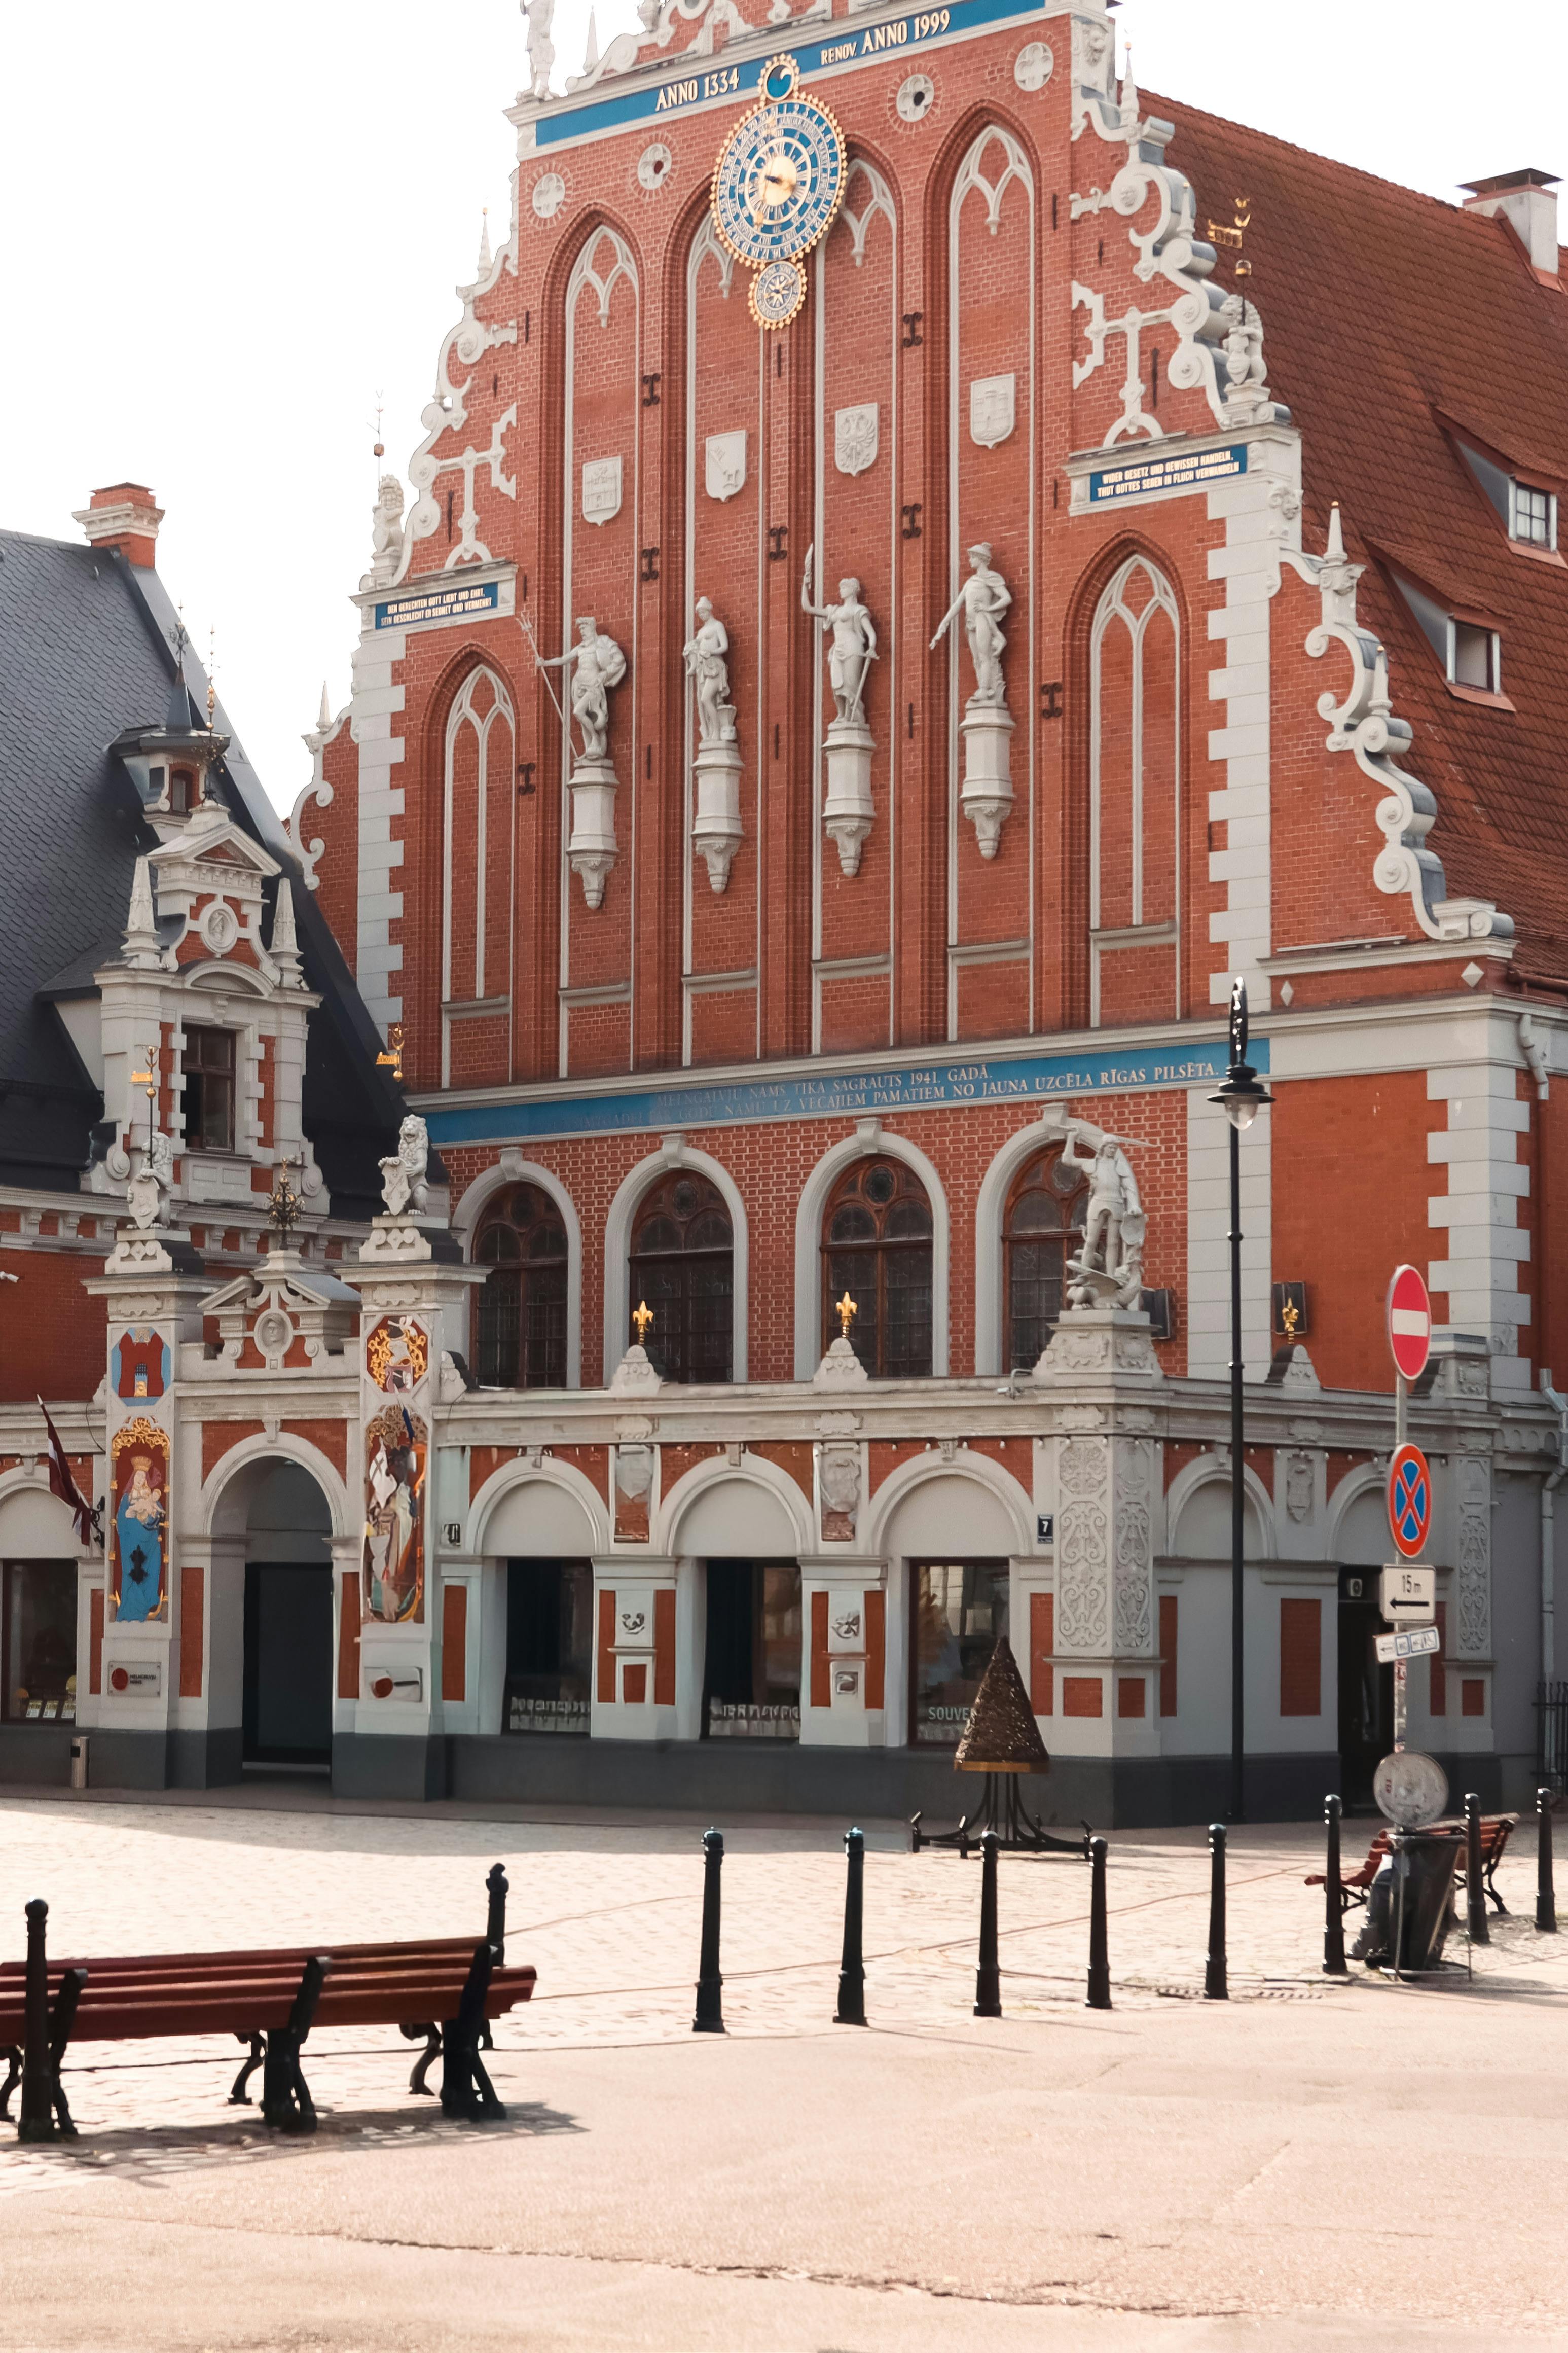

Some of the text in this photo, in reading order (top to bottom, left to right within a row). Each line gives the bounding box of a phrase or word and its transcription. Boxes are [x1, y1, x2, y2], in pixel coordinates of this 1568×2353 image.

[820, 8, 950, 65] RENOV. ANNO 1999
[655, 67, 740, 112] ANNO 1334
[1097, 462, 1239, 497] THUT GOTTES SEGEN IN FLUCH VERWANDELN
[1102, 472, 1123, 484] WIDER
[1125, 466, 1149, 480] GESETZ
[1150, 463, 1164, 475] UND
[1165, 457, 1199, 472] GEWISSEN
[381, 597, 492, 626] SEIN GESCHLECHT ER SEGNET UND VERMEHRT
[387, 604, 398, 614] DEN
[399, 598, 427, 612] GERECHTEN
[428, 596, 442, 607] GOTT
[443, 593, 457, 603] LIEBT
[459, 590, 469, 600] UND
[750, 1085, 785, 1099] NAMS
[794, 1082, 825, 1095] TIKA
[833, 1074, 902, 1092] SAGRAUTS
[910, 1071, 941, 1085] 1941.
[947, 1064, 993, 1082] GADĀ.
[799, 1093, 866, 1110] VECAJIEM
[873, 1086, 945, 1103] PAMATIEM
[953, 1083, 975, 1097] NO
[982, 1079, 1028, 1096] JAUNA
[1035, 1073, 1093, 1090] UZCĒLA
[1100, 1068, 1146, 1085] RĪGAS
[1154, 1062, 1219, 1080] PILSĒTA.
[1042, 1521, 1049, 1532] 7
[1401, 1574, 1422, 1593] 15 m
